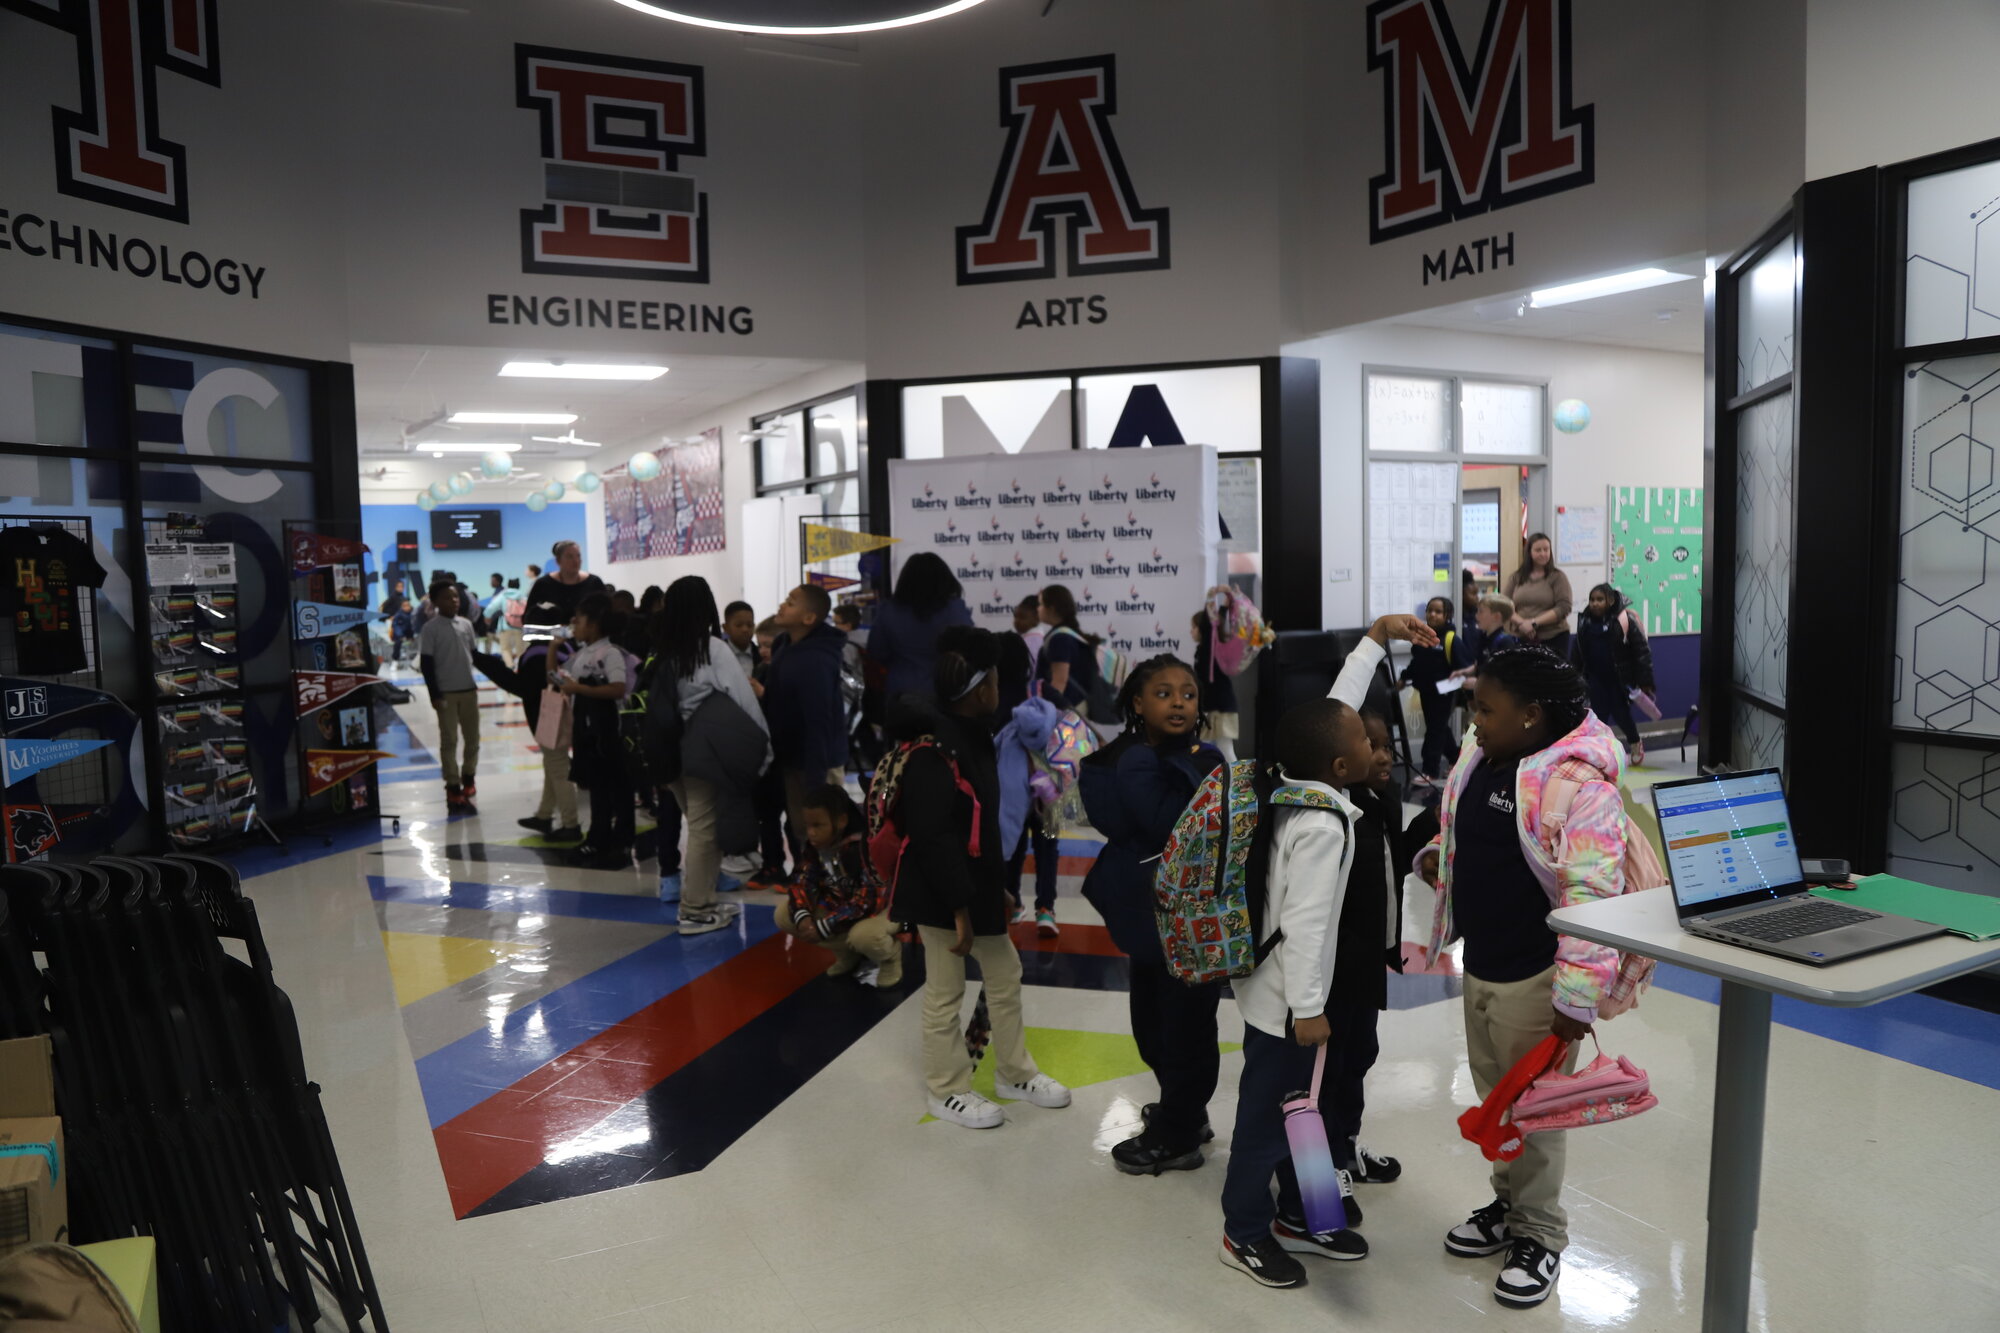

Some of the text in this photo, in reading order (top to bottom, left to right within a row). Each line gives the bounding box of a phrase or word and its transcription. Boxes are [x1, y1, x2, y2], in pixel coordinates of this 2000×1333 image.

[1367, 0, 1596, 246] M
[514, 42, 708, 284] E
[956, 54, 1171, 287] A
[1423, 232, 1515, 287] MATH
[487, 293, 754, 336] ENGINEERING
[1016, 295, 1108, 329] ARTS
[911, 488, 1176, 510] liberty liberty liberty liberty liberty liberty
[934, 526, 1153, 545] liberty liberty liberty liberty liberty
[957, 562, 1178, 581] liberty liberty liberty liberty liberty
[1115, 601, 1155, 614] liberty
[322, 612, 364, 626] SPELMAN
[1140, 637, 1180, 650] liberty
[1489, 791, 1515, 813] liberty
